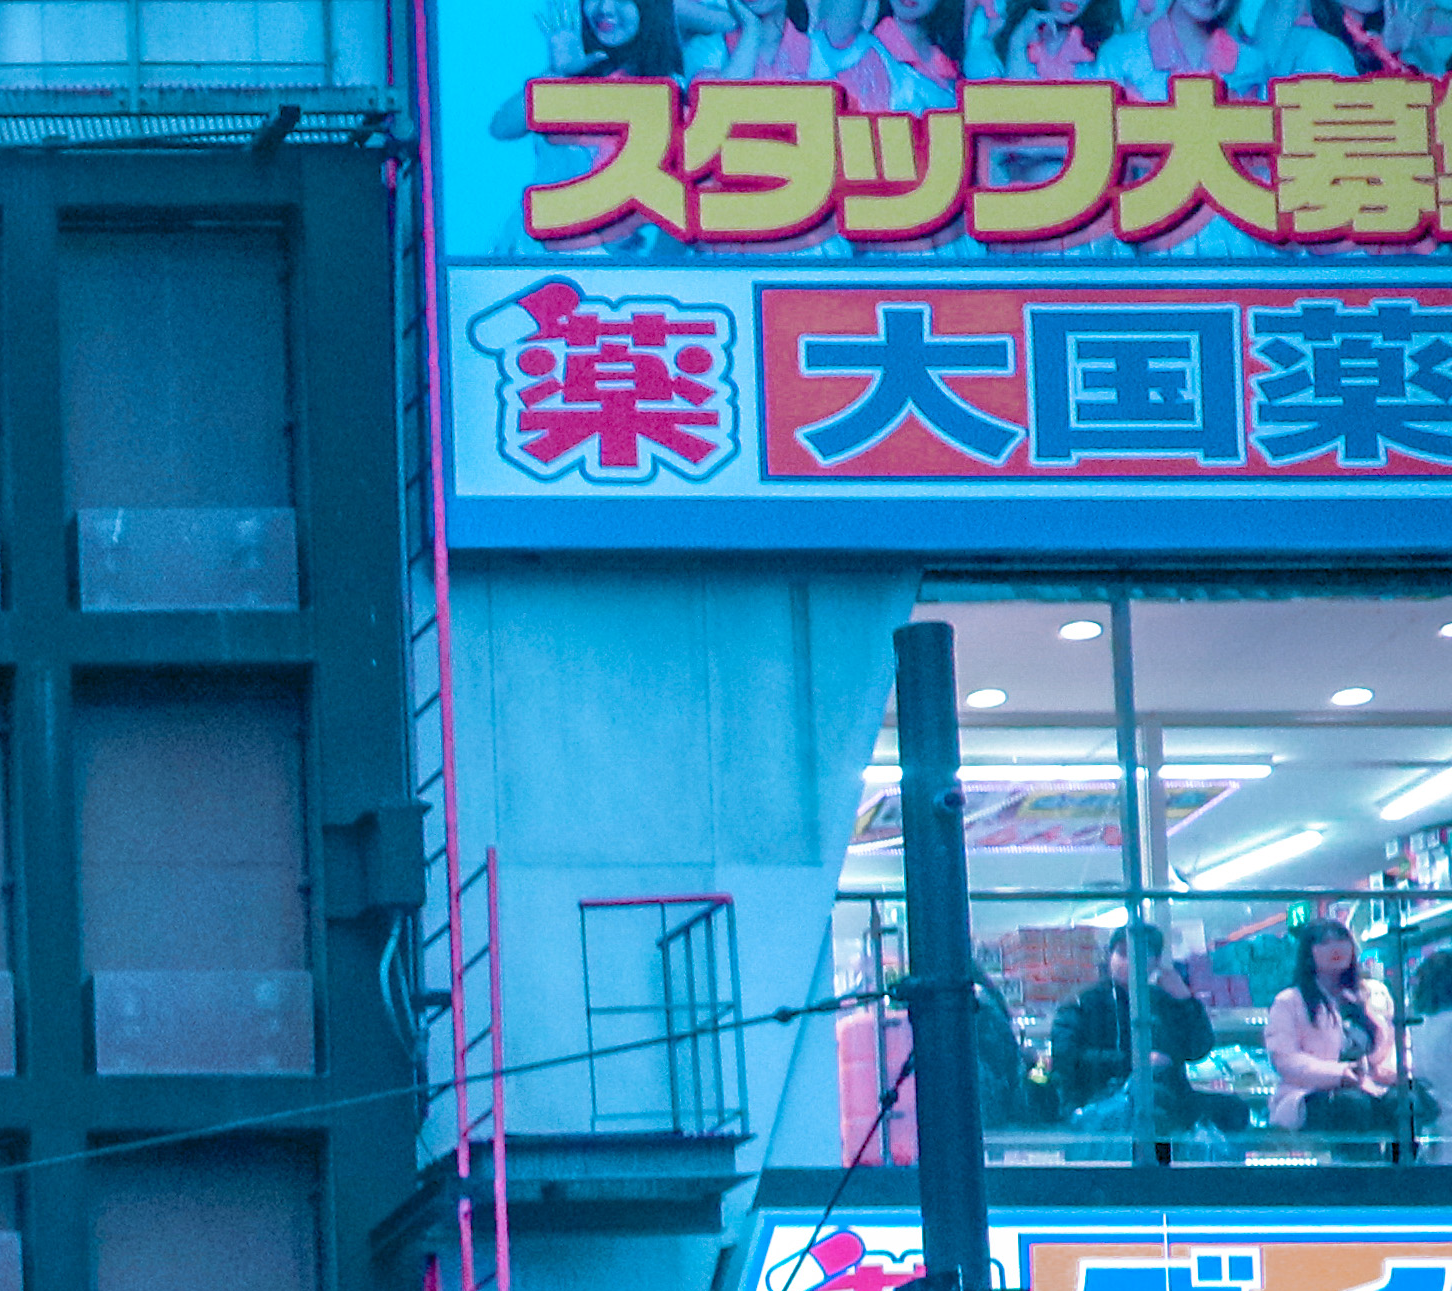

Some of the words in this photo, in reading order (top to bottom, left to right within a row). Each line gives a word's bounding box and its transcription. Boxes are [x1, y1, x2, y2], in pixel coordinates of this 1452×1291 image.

[526, 76, 1452, 241] スタッフ大募
[517, 300, 724, 470] 薬
